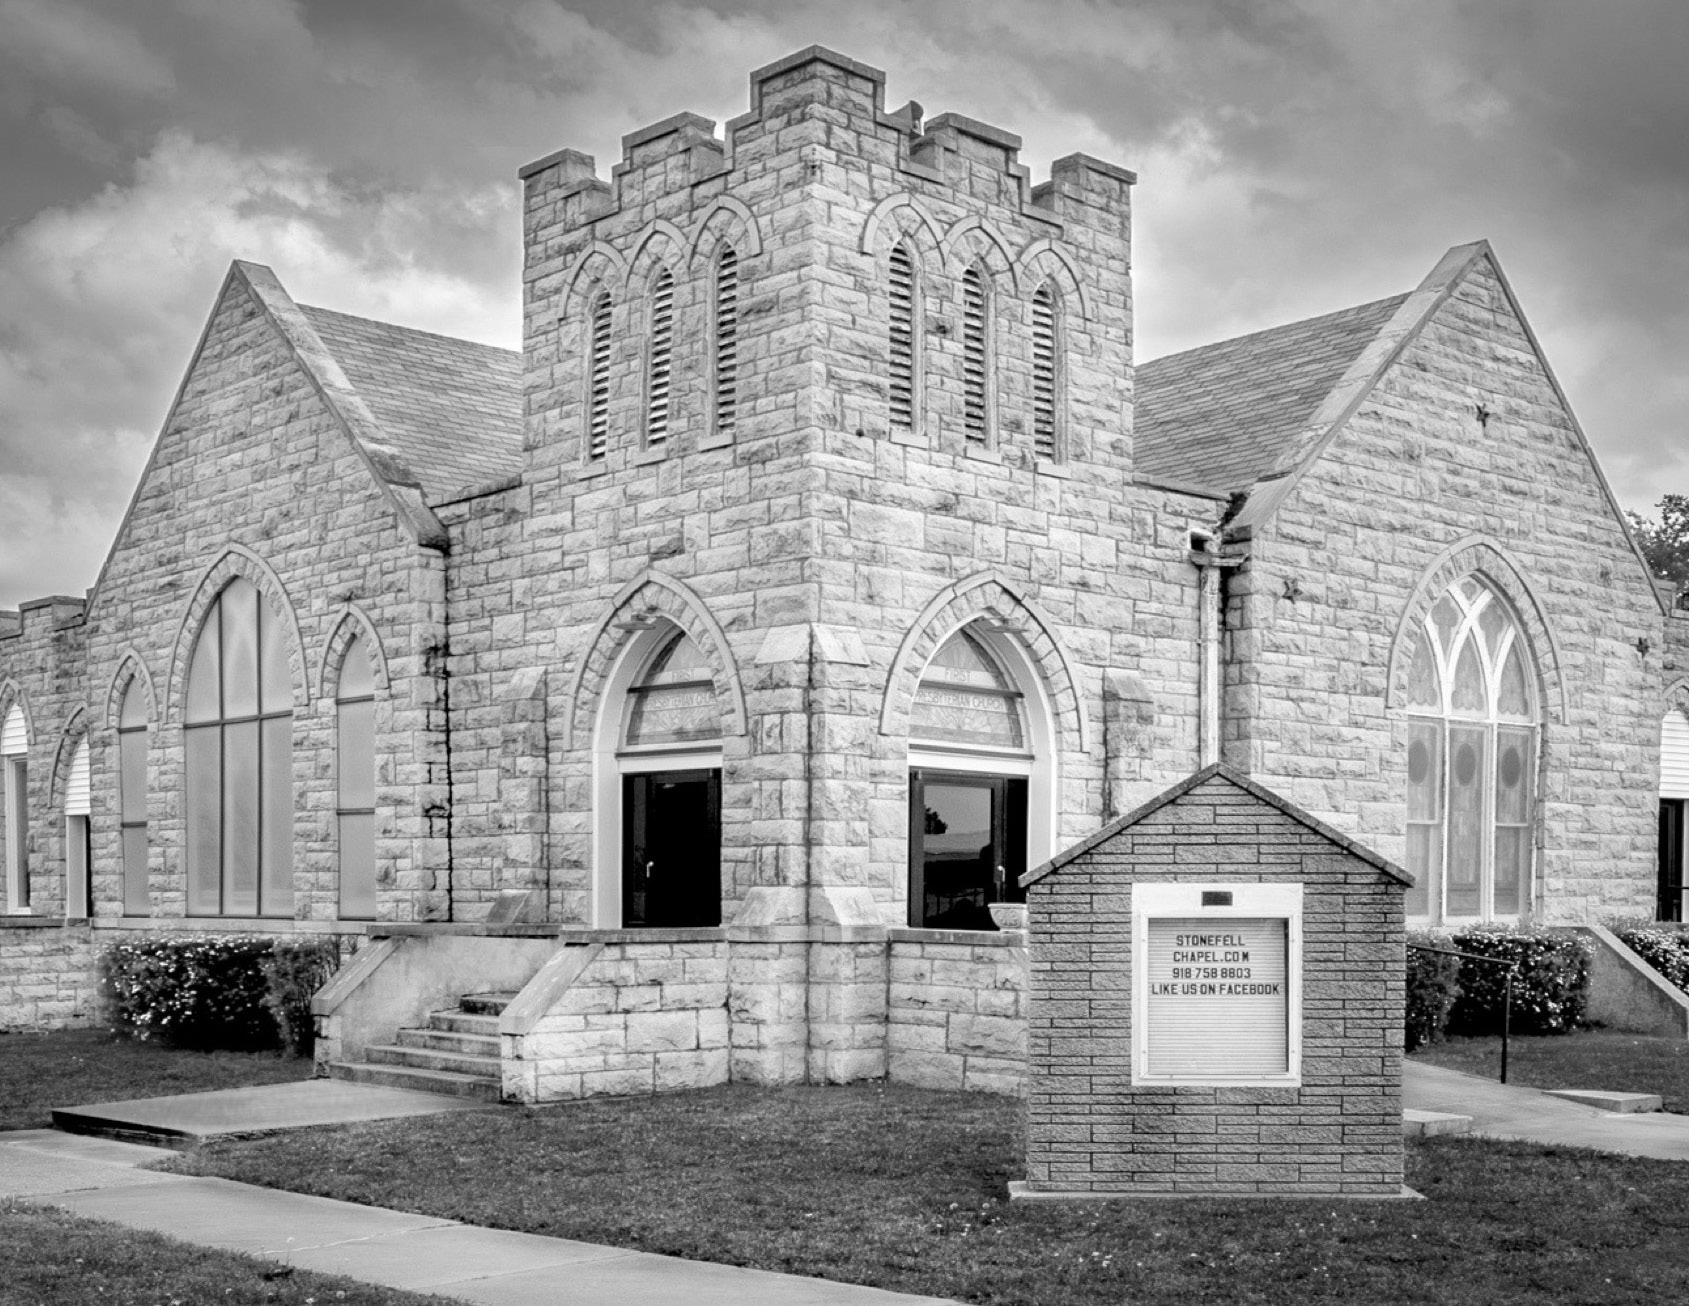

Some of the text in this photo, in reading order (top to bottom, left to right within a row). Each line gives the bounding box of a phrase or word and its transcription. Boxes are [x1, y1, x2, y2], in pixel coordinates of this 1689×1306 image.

[945, 668, 970, 682] FIRST
[1176, 935, 1245, 946] STONEFELL
[1172, 967, 1251, 979] 918 758 8803
[1151, 984, 1280, 995] LIKE US ON FACEBOOK
